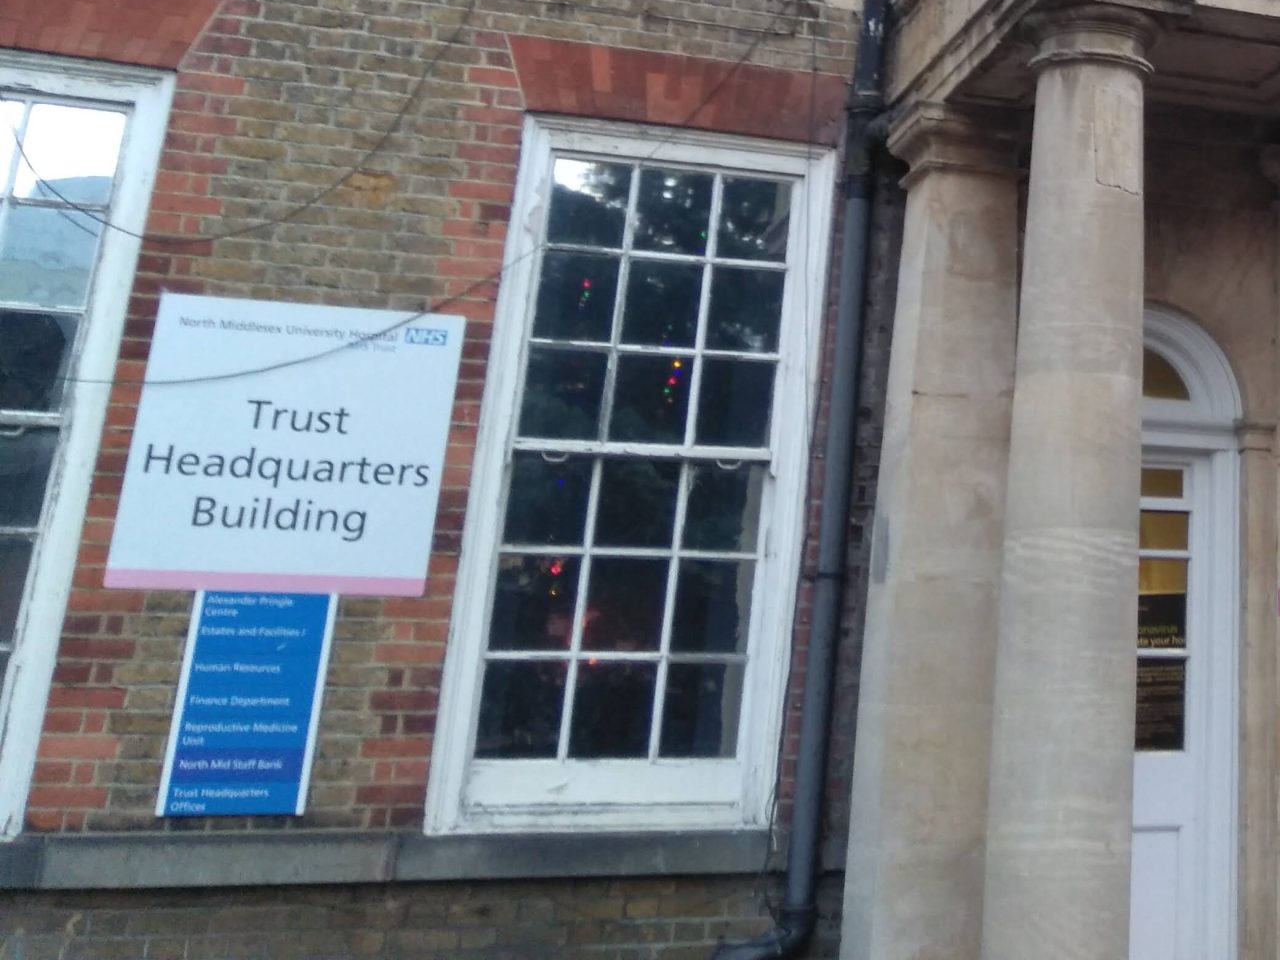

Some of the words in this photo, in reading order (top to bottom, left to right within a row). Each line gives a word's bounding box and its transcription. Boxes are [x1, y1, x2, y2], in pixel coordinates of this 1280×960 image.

[179, 315, 216, 329] North
[219, 319, 281, 335] Middlesex
[286, 325, 345, 340] University
[405, 329, 447, 345] NHS
[248, 399, 350, 435] Trust
[142, 443, 430, 488] Headquarters
[190, 496, 367, 542] Building
[237, 626, 257, 637] and
[179, 759, 209, 770] North
[257, 760, 282, 770] Bank
[173, 788, 198, 799] Trust
